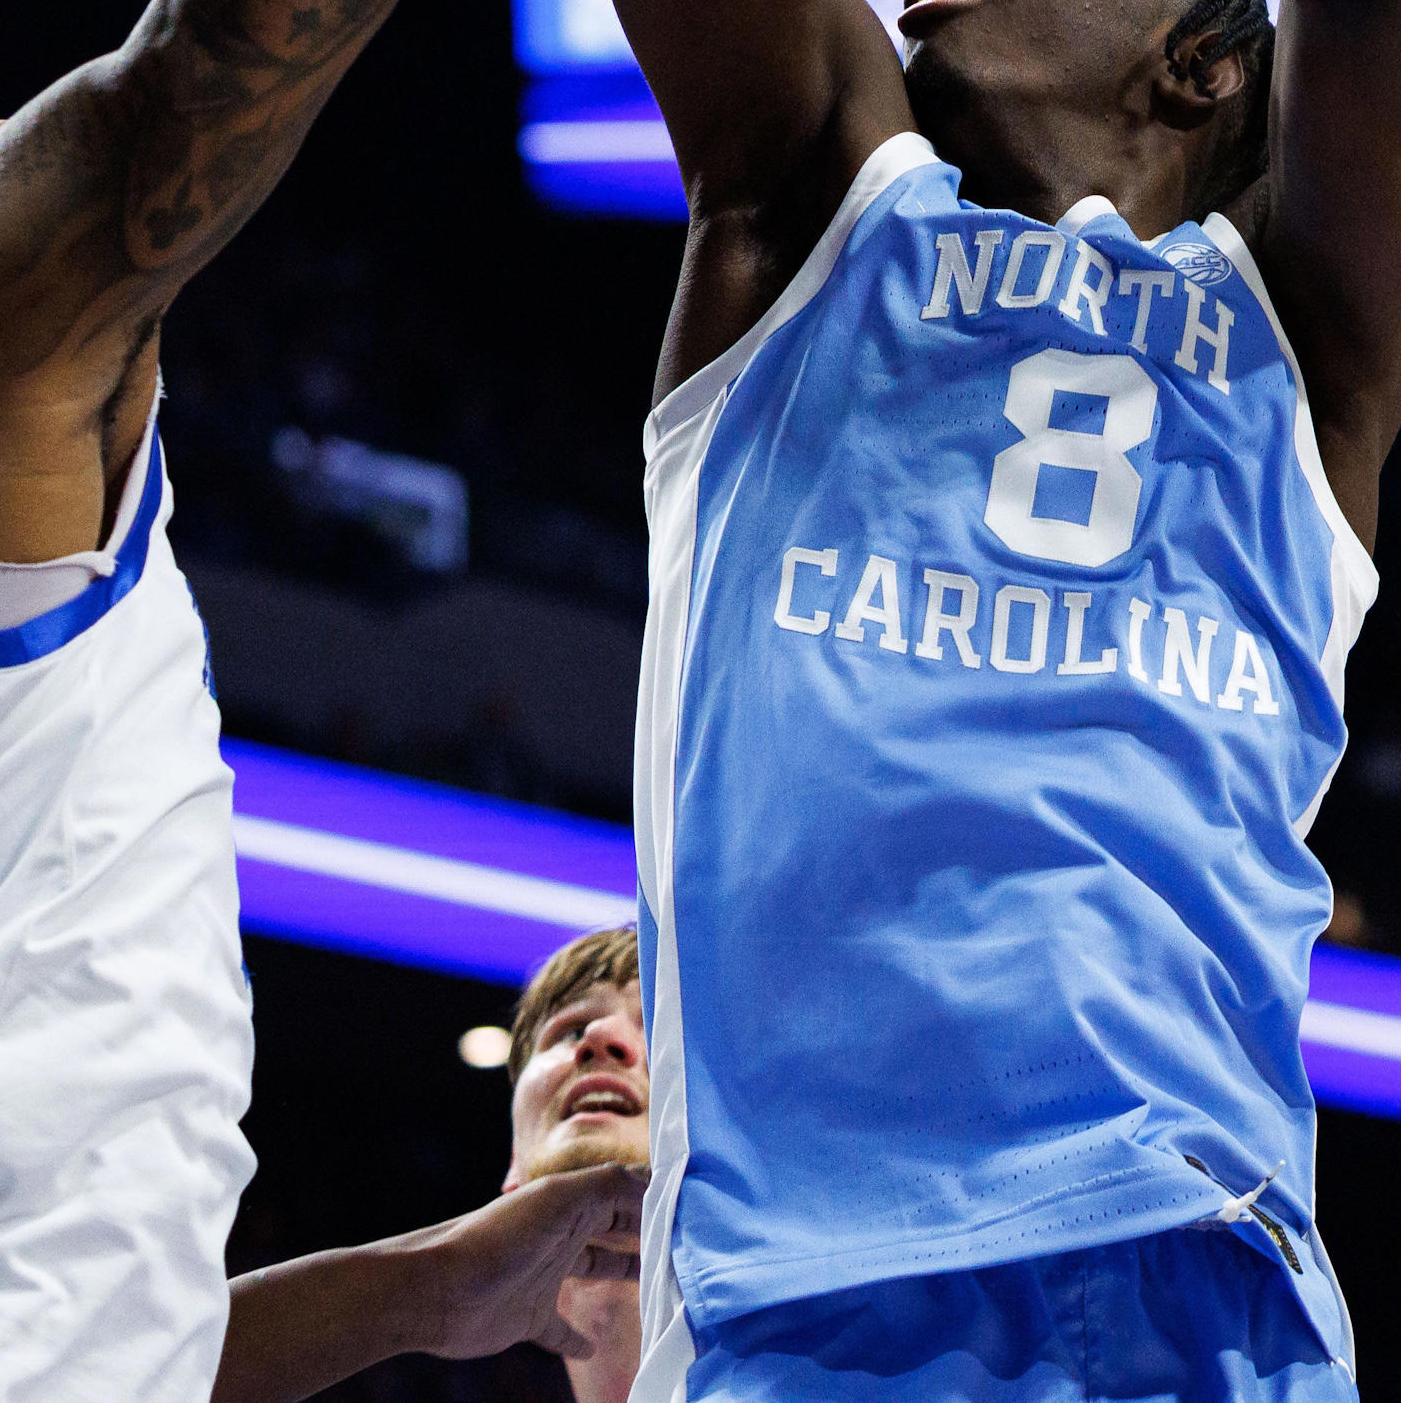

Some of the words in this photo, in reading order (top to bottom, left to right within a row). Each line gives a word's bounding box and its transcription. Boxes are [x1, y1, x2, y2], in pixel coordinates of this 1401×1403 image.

[920, 229, 1236, 396] NORTH
[983, 346, 1159, 569] 8
[773, 546, 1280, 718] CAROLINA
